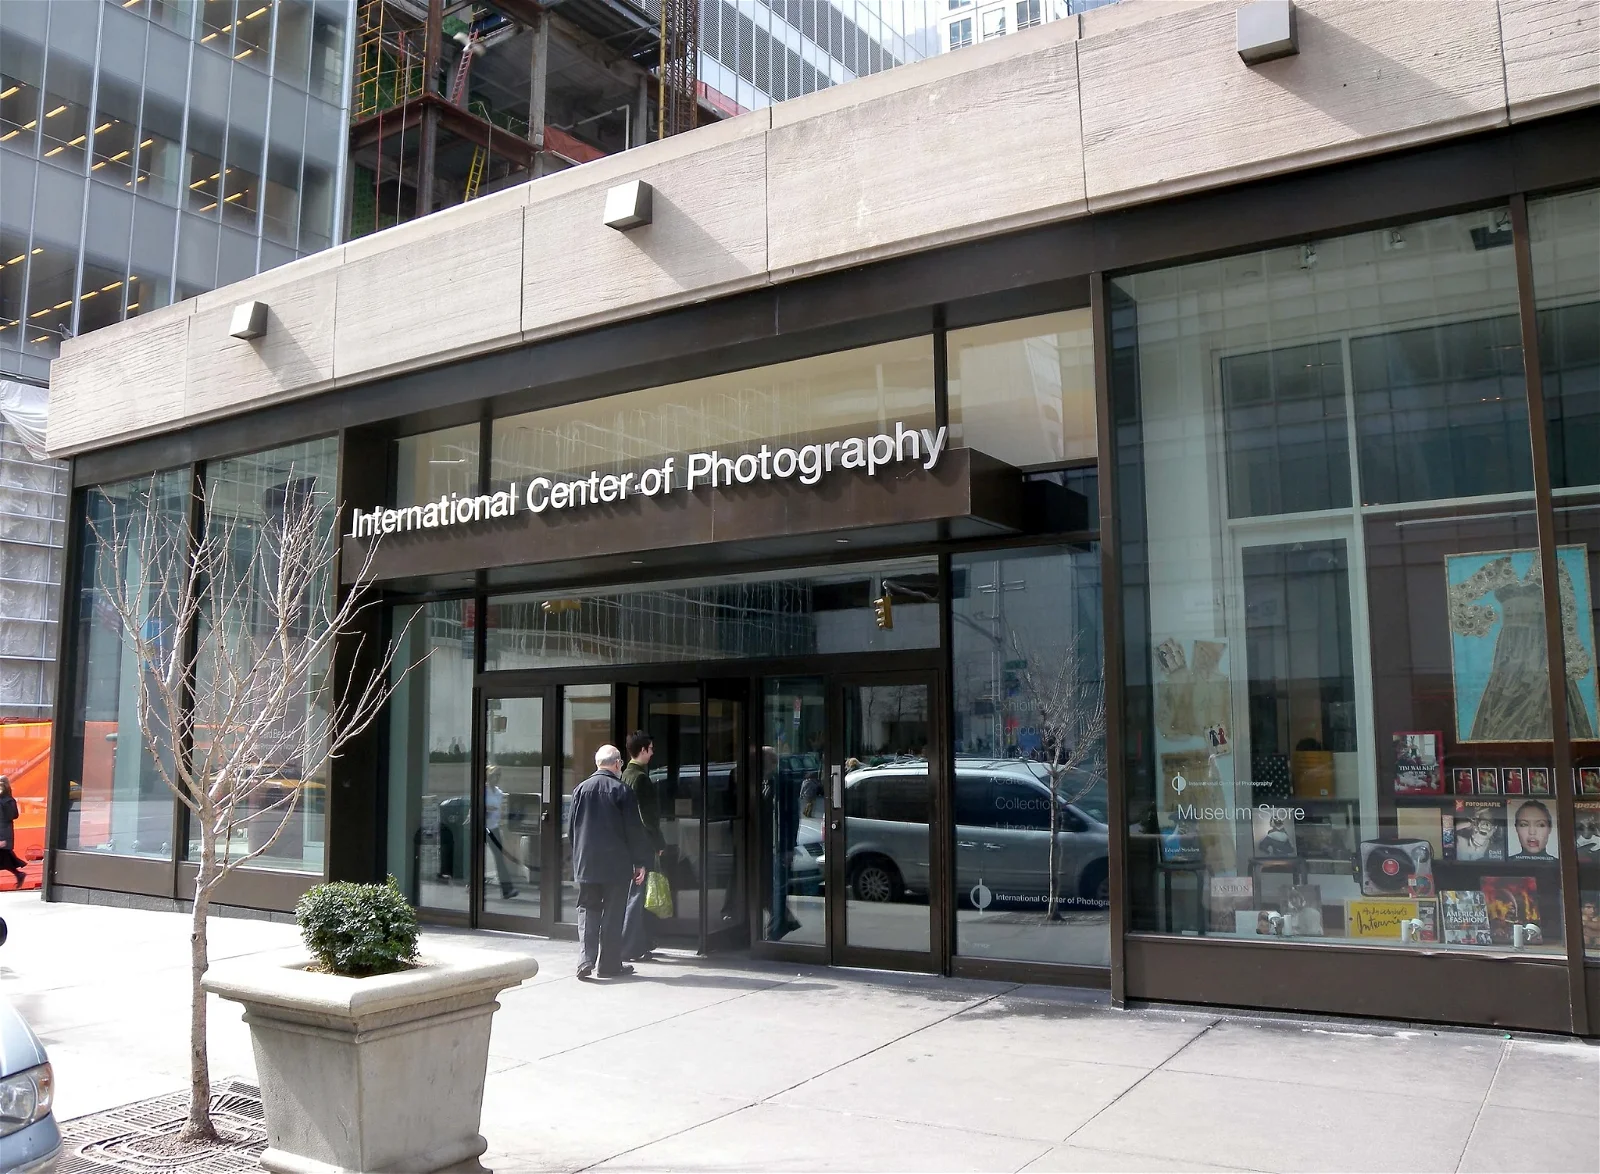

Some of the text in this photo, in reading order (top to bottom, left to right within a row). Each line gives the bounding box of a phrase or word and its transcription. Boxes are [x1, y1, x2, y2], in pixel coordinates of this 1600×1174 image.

[351, 421, 949, 539] International Center of Photography
[1241, 780, 1274, 788] Photography
[1177, 803, 1306, 822] Museum Store
[1214, 884, 1250, 893] FASHION
[995, 893, 1040, 903] International
[1067, 895, 1075, 904] of
[1450, 916, 1485, 924] FASHION
